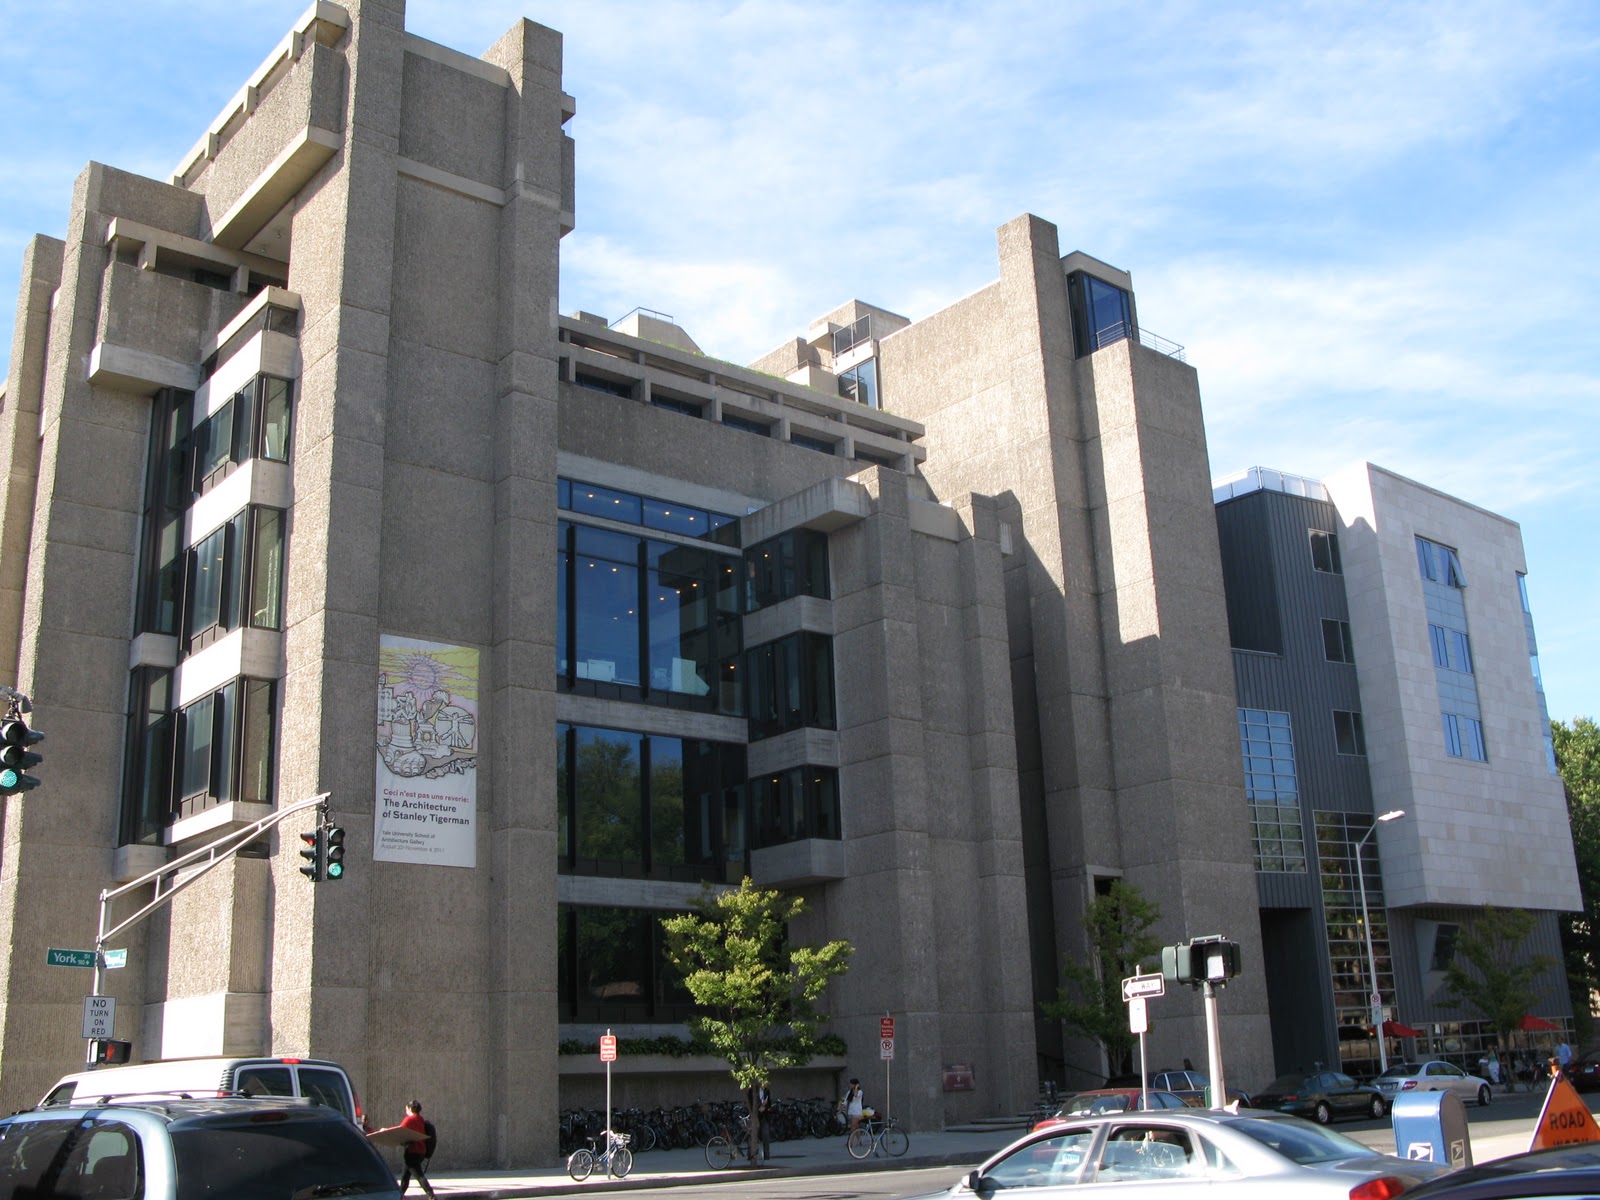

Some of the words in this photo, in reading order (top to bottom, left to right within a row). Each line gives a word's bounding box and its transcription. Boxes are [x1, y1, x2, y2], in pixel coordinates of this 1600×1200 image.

[383, 788, 399, 796] Ceci
[399, 790, 416, 798] n'est
[383, 798, 400, 807] The
[402, 800, 457, 812] Architecture
[382, 810, 391, 818] of
[393, 811, 427, 823] Stanley
[429, 813, 470, 825] Tigerman
[54, 952, 77, 965] York
[92, 999, 107, 1008] NO
[1549, 1111, 1586, 1131] ROAD
